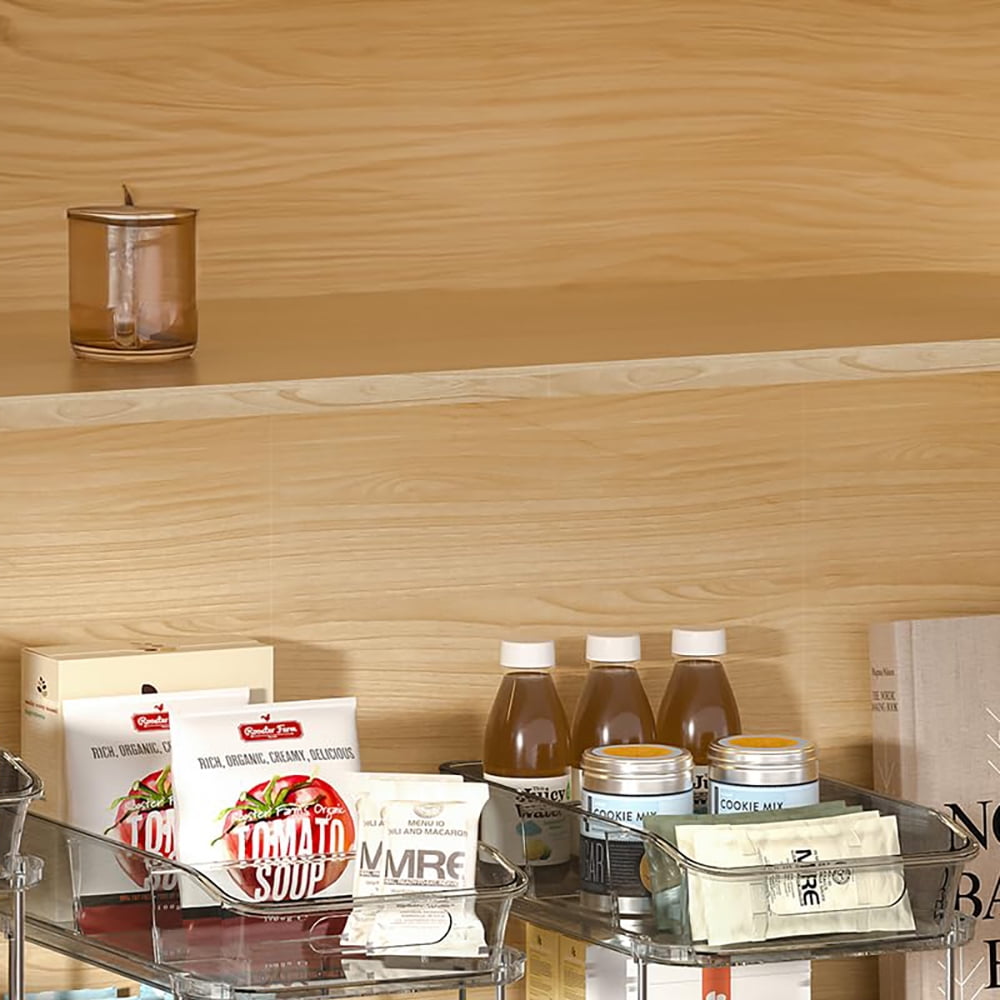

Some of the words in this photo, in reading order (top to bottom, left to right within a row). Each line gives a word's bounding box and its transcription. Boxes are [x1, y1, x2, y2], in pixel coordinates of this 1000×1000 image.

[90, 746, 119, 760] RICH,
[119, 742, 162, 757] ORGANIC,
[197, 757, 225, 770] RICH,
[225, 752, 270, 768] ORGANIC,
[310, 746, 356, 761] DELICIOUS
[594, 808, 633, 822] COOKIE
[720, 798, 760, 812] COOKIE
[762, 802, 784, 811] MIX
[235, 816, 346, 868] TOMATO
[384, 849, 466, 880] MRE
[254, 860, 326, 902] SOUP
